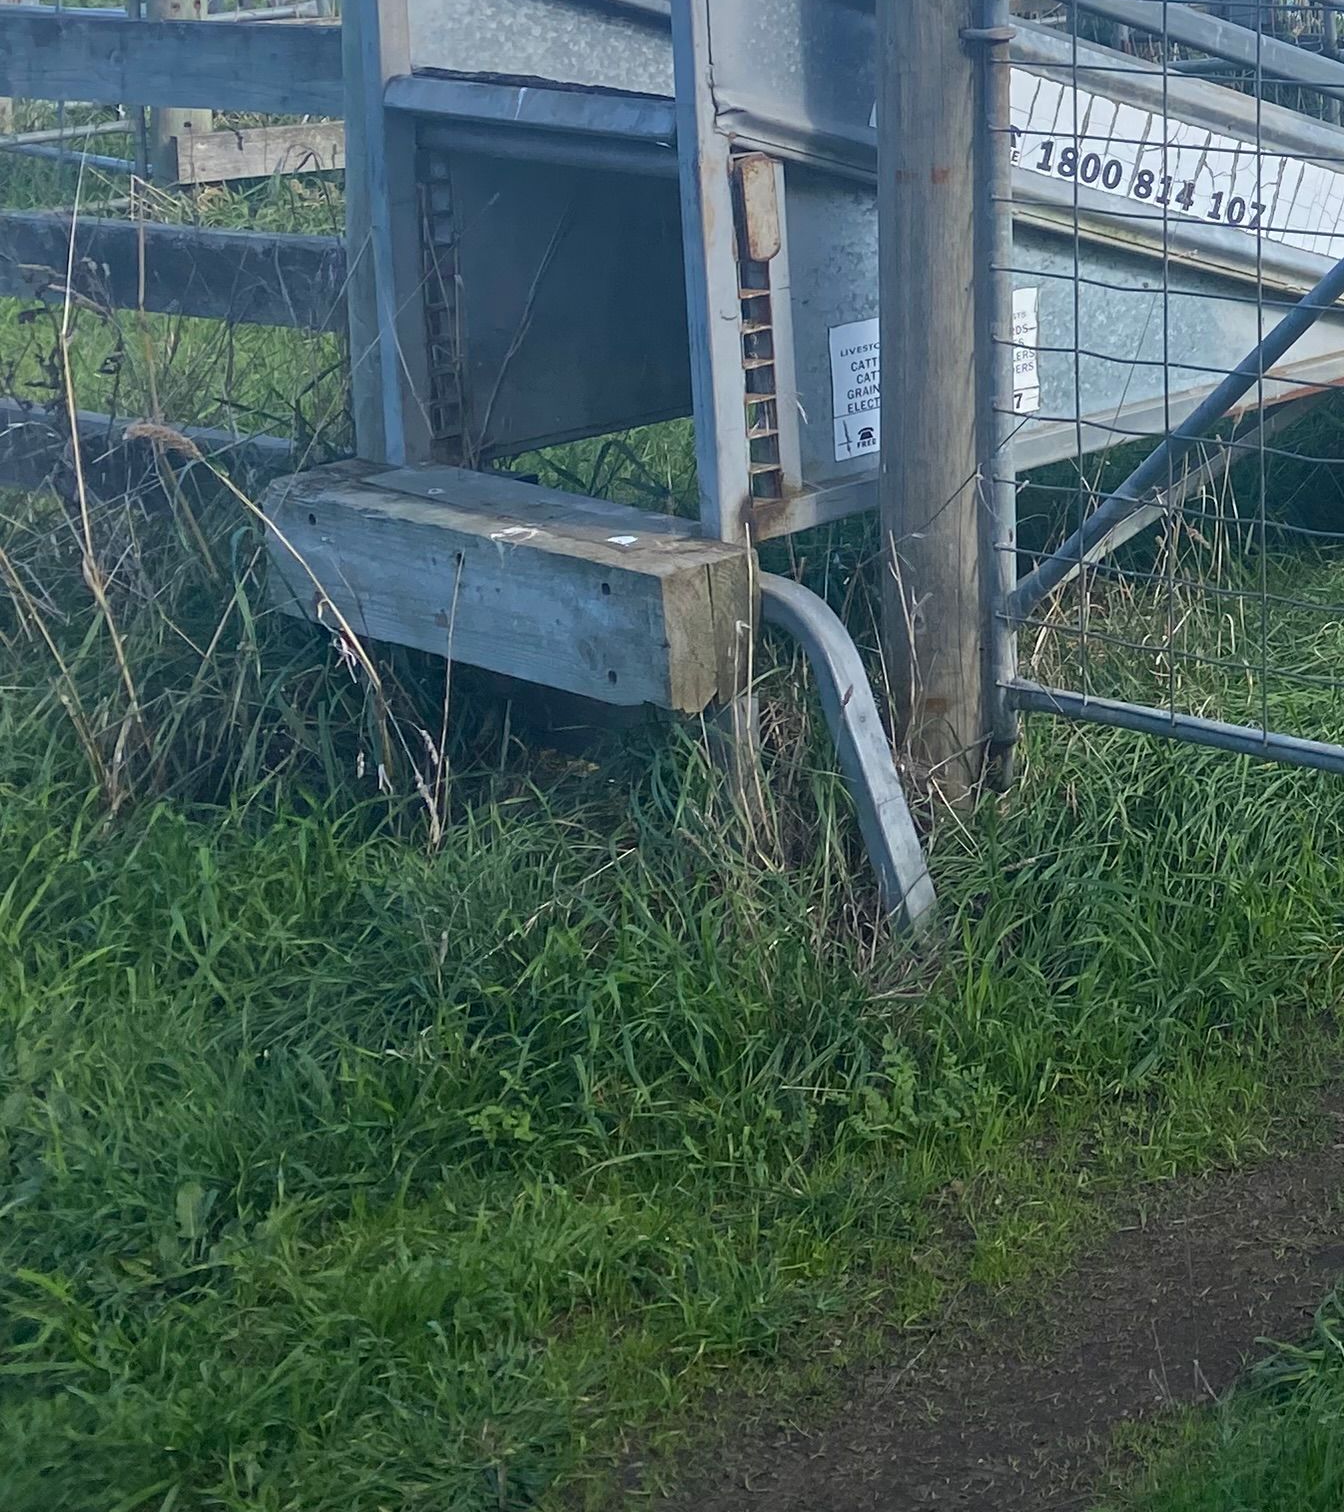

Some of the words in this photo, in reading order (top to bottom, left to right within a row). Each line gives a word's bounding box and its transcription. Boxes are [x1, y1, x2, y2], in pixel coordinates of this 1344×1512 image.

[1036, 140, 1123, 190] 1800
[1133, 169, 1195, 212] 814
[1207, 191, 1266, 231] 107
